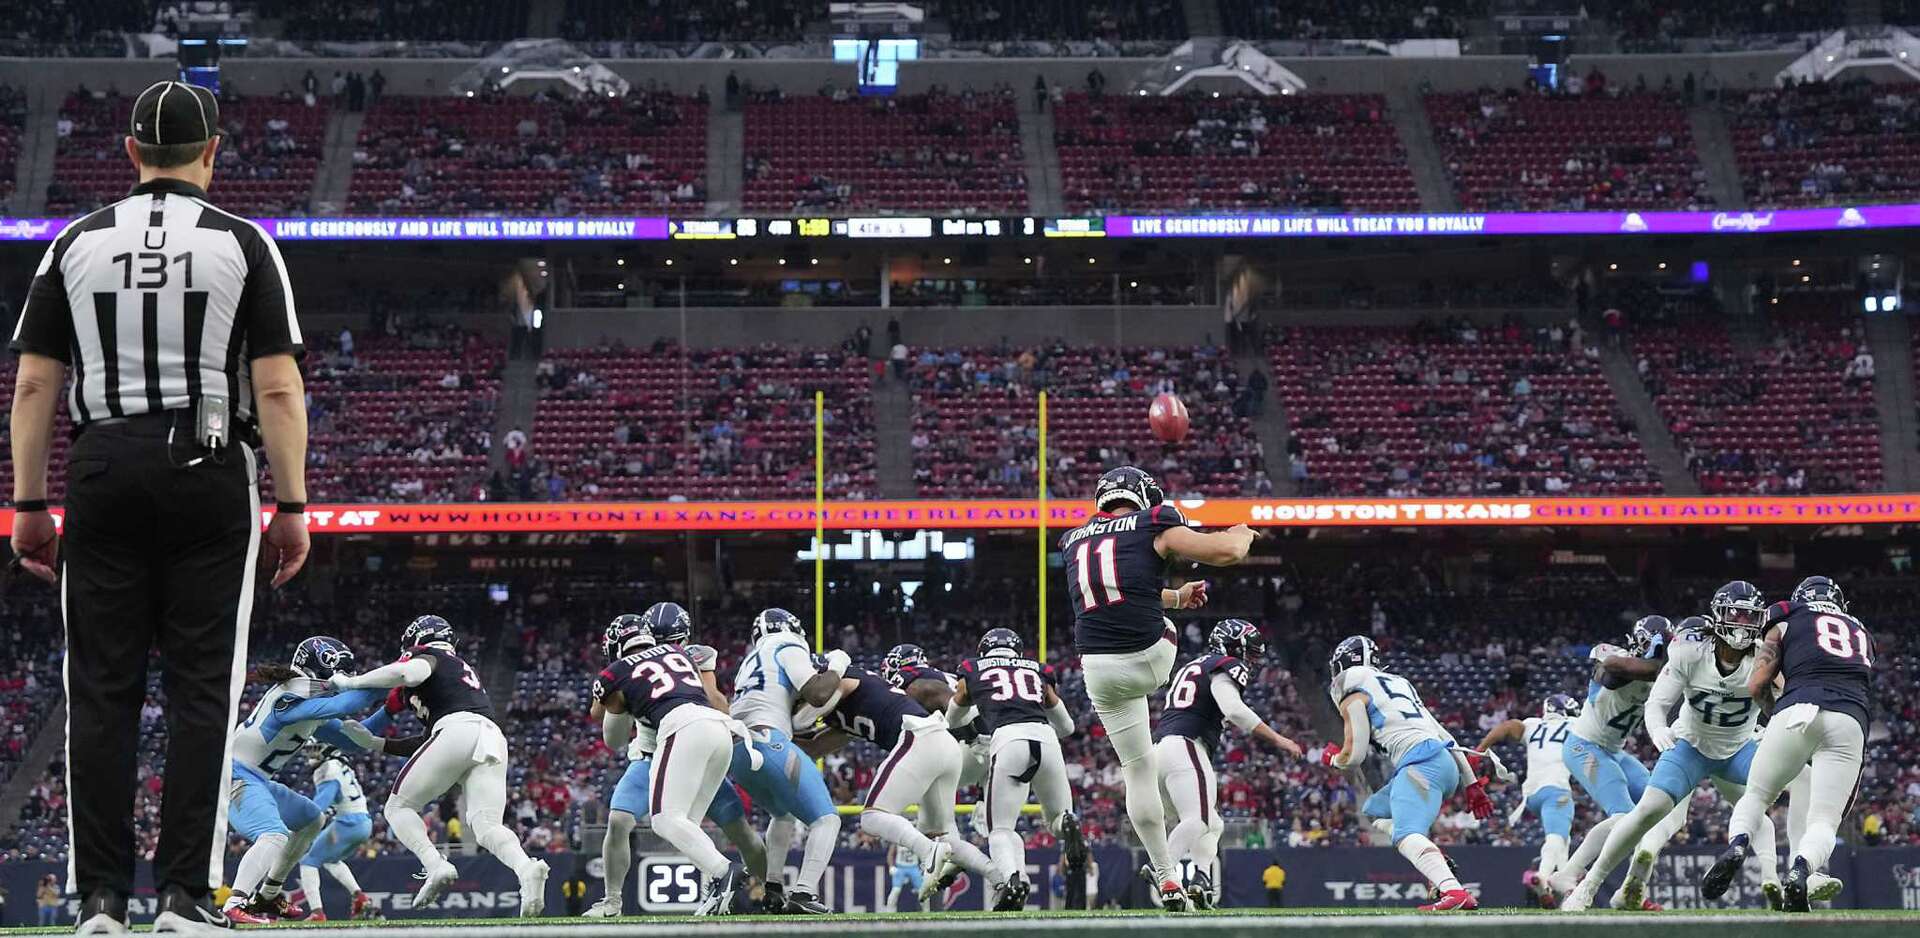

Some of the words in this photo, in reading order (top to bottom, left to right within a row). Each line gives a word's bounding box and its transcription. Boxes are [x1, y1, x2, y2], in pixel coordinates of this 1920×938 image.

[144, 231, 165, 249] U
[276, 221, 307, 237] LIVE
[310, 221, 397, 237] GENEROUSLY
[400, 221, 428, 237] AND
[432, 221, 462, 236] LIFE
[465, 221, 498, 236] WILL
[502, 221, 543, 236] TREAT
[547, 221, 574, 236] YOU
[577, 221, 636, 236] ROYALLY
[1132, 219, 1162, 234] LIVE
[1165, 219, 1249, 234] GENEROUSLY
[1252, 218, 1281, 233] AND
[1284, 218, 1313, 233] LIFE
[1316, 218, 1349, 233] WILL
[1353, 217, 1394, 232] TREAT
[1397, 217, 1425, 232] YOU
[1428, 216, 1485, 232] ROYALLY
[112, 252, 193, 289] 131
[339, 511, 380, 526] AT
[1251, 505, 1397, 520] HOUSTON
[1400, 503, 1532, 520] TEXANS
[1536, 504, 1782, 517] CHEERLEADERS
[1065, 515, 1138, 549] JOHNSTON
[1073, 537, 1123, 609] 11
[1815, 614, 1872, 669] 81
[631, 653, 703, 699] 39
[979, 667, 1043, 703] 30
[1228, 664, 1249, 687] 46
[1688, 691, 1753, 728] 42
[1528, 720, 1570, 749] 44
[650, 864, 698, 903] 25
[1325, 881, 1481, 901] TEXAS
